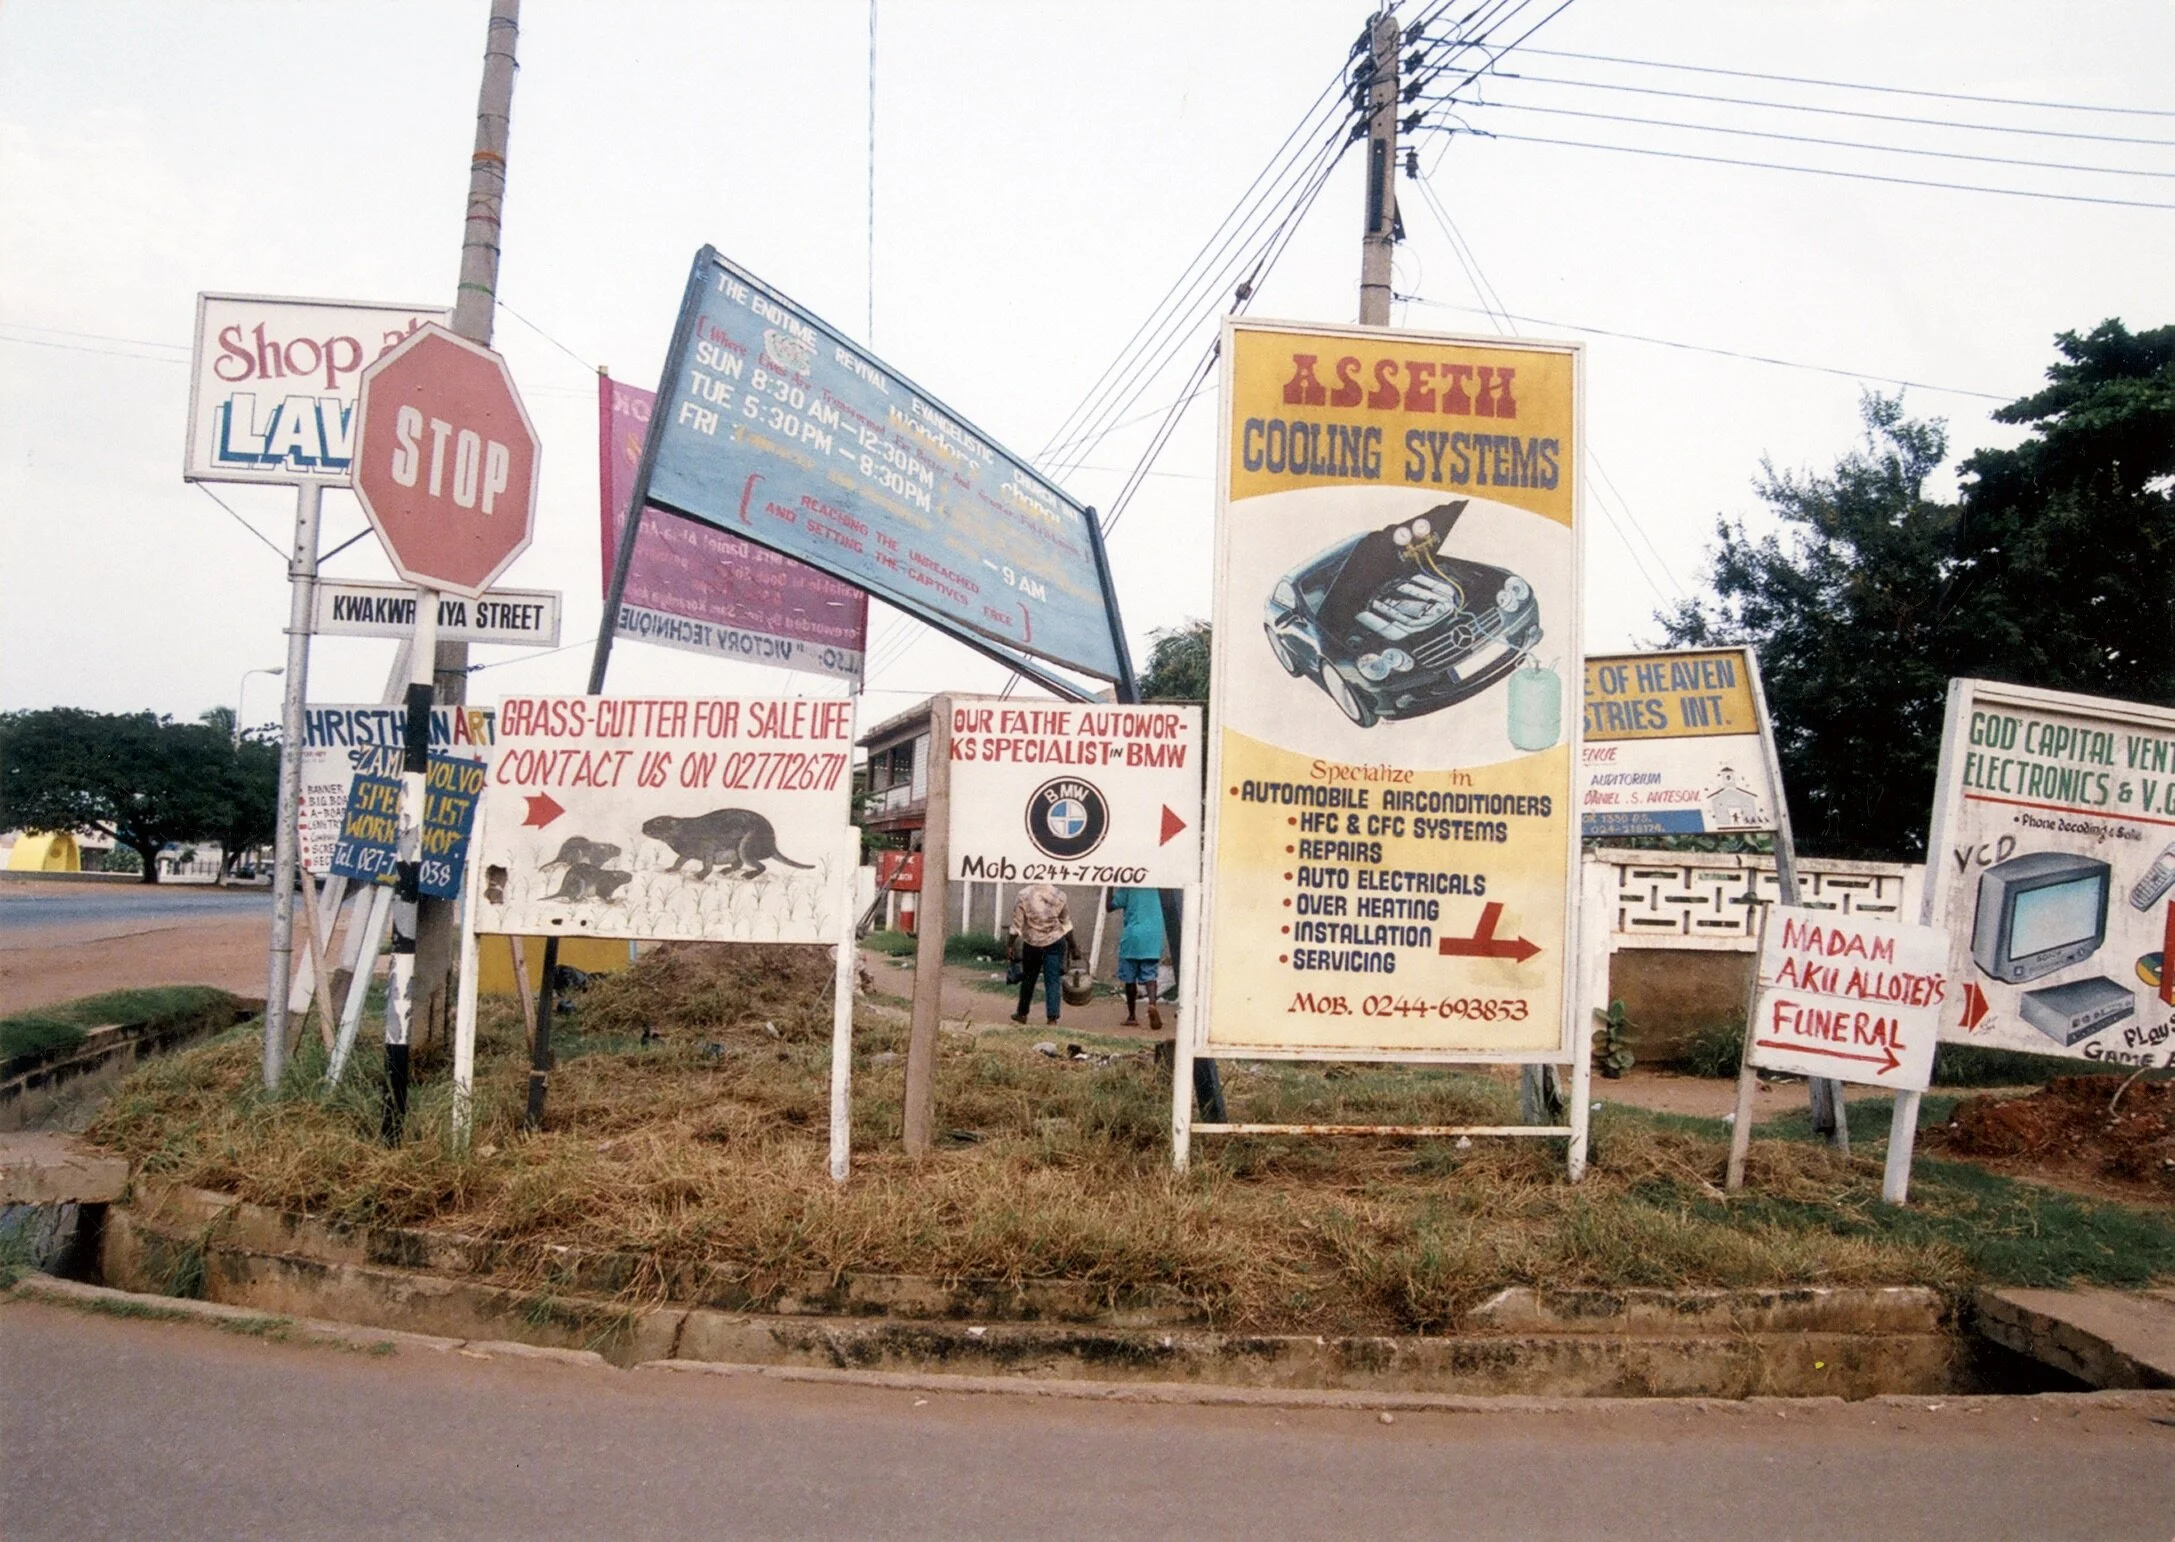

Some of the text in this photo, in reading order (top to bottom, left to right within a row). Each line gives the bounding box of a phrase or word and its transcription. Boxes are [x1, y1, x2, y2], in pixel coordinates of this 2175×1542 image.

[213, 321, 364, 390] Shop
[718, 273, 749, 306] THE
[752, 295, 817, 347] ENDTIME
[835, 347, 889, 395] REVIVAL
[912, 397, 995, 464] EVANGELISTIC
[692, 370, 735, 409] TUE
[696, 341, 744, 381] SUN
[751, 368, 805, 409] 8:30
[1282, 353, 1517, 419] ASSETH
[391, 404, 510, 515] STOP
[1242, 418, 1560, 490] COOLING SYSTEMS
[678, 401, 718, 436] FRI
[1003, 567, 1015, 586] 9
[1018, 575, 1047, 602] AM
[801, 495, 869, 536] REACHING
[875, 531, 898, 552] THE
[909, 550, 979, 594] UNREACHED
[765, 502, 1013, 626] AND SETTING THE CAPTIVES FREE
[476, 602, 544, 630] STREET
[1600, 665, 1629, 695] OF
[1636, 659, 1735, 693] HEAVEN
[453, 706, 496, 746] ART
[500, 699, 852, 740] GRASS-CUTTER FOR SALE LIFE
[954, 709, 1188, 739] OUR FATHE AUTOWOR-
[1680, 695, 1732, 727] INT.
[950, 737, 977, 761] KS
[982, 738, 1112, 765] SPECIALIST
[1126, 743, 1187, 768] BMW
[2025, 721, 2115, 766] CAPITAL
[426, 762, 484, 795] VOLVO
[496, 749, 847, 791] CONTACT US ON 0277126711
[1309, 759, 1474, 787] Specialize in
[1590, 772, 1661, 786] AUDITORIUM
[1962, 752, 2109, 805] ELECTRONICS
[2118, 782, 2133, 803] &
[1043, 784, 1089, 804] BMW
[1241, 780, 1552, 817] AUTOMOBILE AIRCONDITIONERS
[1300, 813, 1508, 844] HFC & CFC SYSTEMS
[2022, 813, 2056, 831] Phone
[961, 855, 1017, 880] Mob
[1299, 840, 1383, 864] REPAIRS
[1954, 835, 2017, 874] VCD
[1297, 866, 1486, 897] AUTO ELECTRICALS
[1296, 894, 1439, 921] OVER HEATING
[1294, 921, 1432, 948] INSTALLATION
[1782, 918, 1895, 964] MADAM
[1293, 949, 1396, 974] SERVICING
[1363, 994, 1529, 1021] 0244-693853
[1773, 1000, 1906, 1050] FUNERAL
